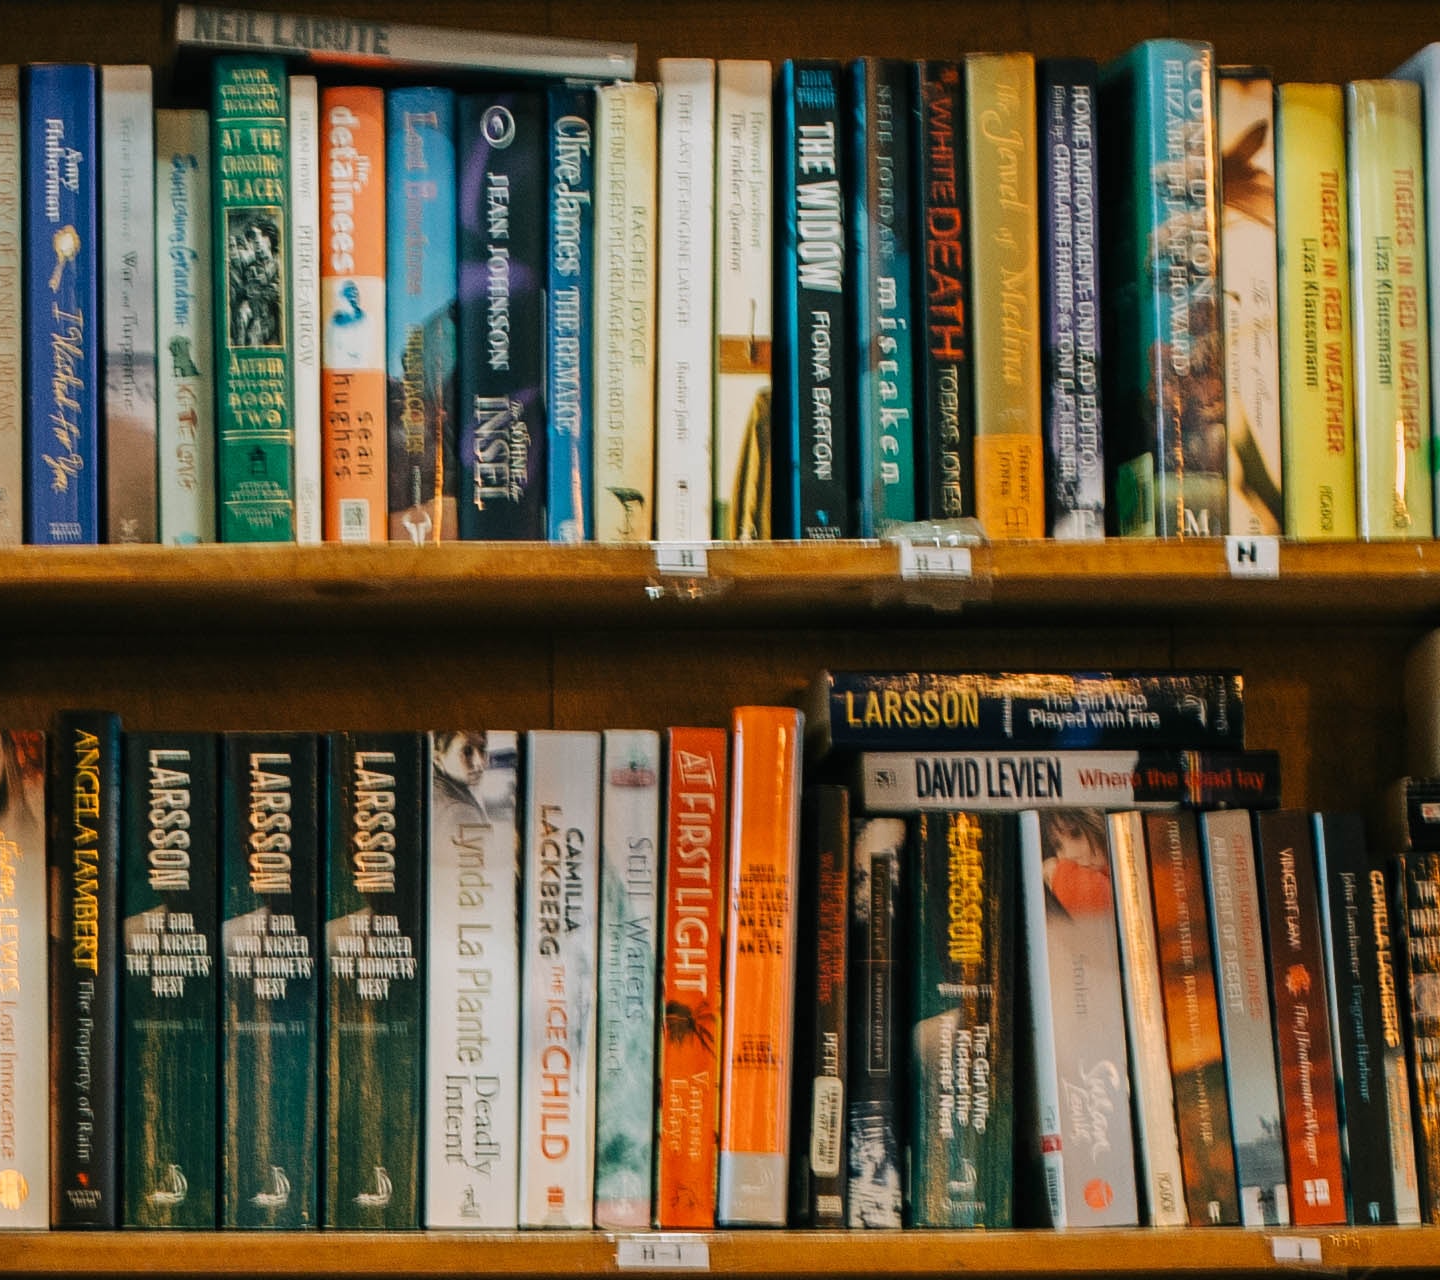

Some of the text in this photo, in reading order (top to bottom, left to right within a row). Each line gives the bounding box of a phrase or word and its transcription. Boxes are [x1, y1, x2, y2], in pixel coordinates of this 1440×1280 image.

[331, 107, 358, 272] detainees
[797, 122, 842, 293] THE WIDOW
[927, 100, 962, 361] WHITE DEATH
[877, 277, 907, 485] mistaken
[845, 690, 980, 729] LARSSON
[915, 757, 1063, 799] DAVID LEVIEN
[148, 749, 190, 890] LARSSON
[248, 753, 292, 893] LARSSON
[353, 752, 396, 893] LARSSON
[675, 751, 715, 996] AT FIRST LIGHT
[451, 823, 493, 1064] Lynda La Plante
[541, 965, 570, 1161] THE ICE CHILD
